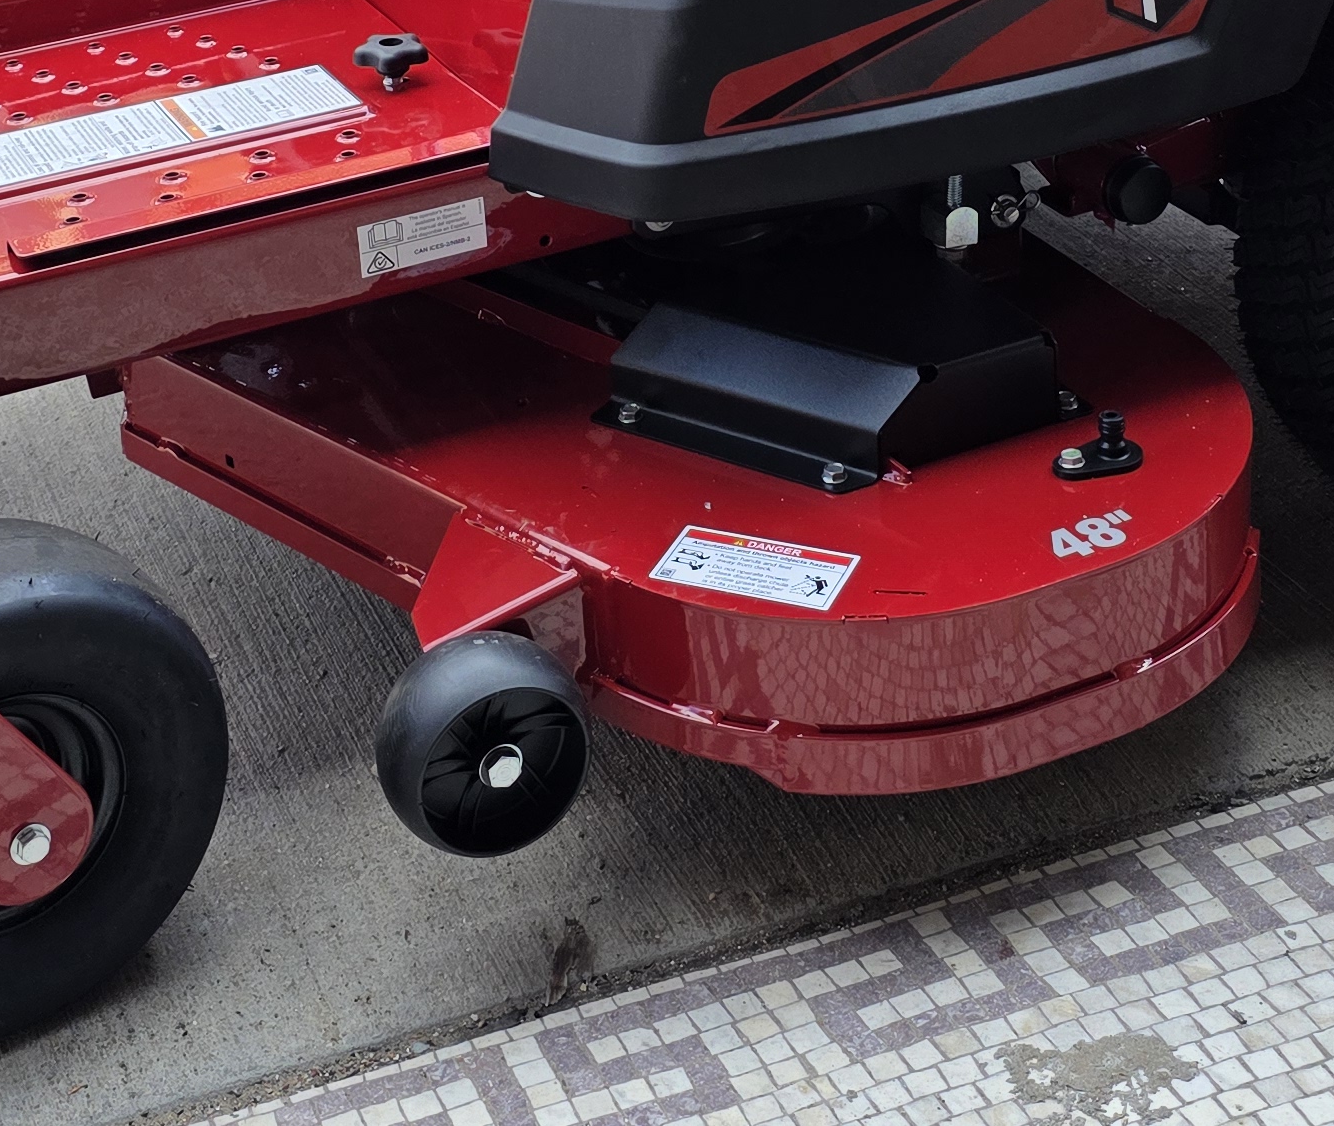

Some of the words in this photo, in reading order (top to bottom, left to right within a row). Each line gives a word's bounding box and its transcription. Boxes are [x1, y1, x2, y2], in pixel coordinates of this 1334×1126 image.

[413, 246, 428, 255] CAN
[1051, 509, 1132, 558] 48"
[745, 540, 803, 556] DANGER
[738, 556, 762, 564] hands
[778, 556, 808, 565] objects
[808, 561, 835, 570] hazard
